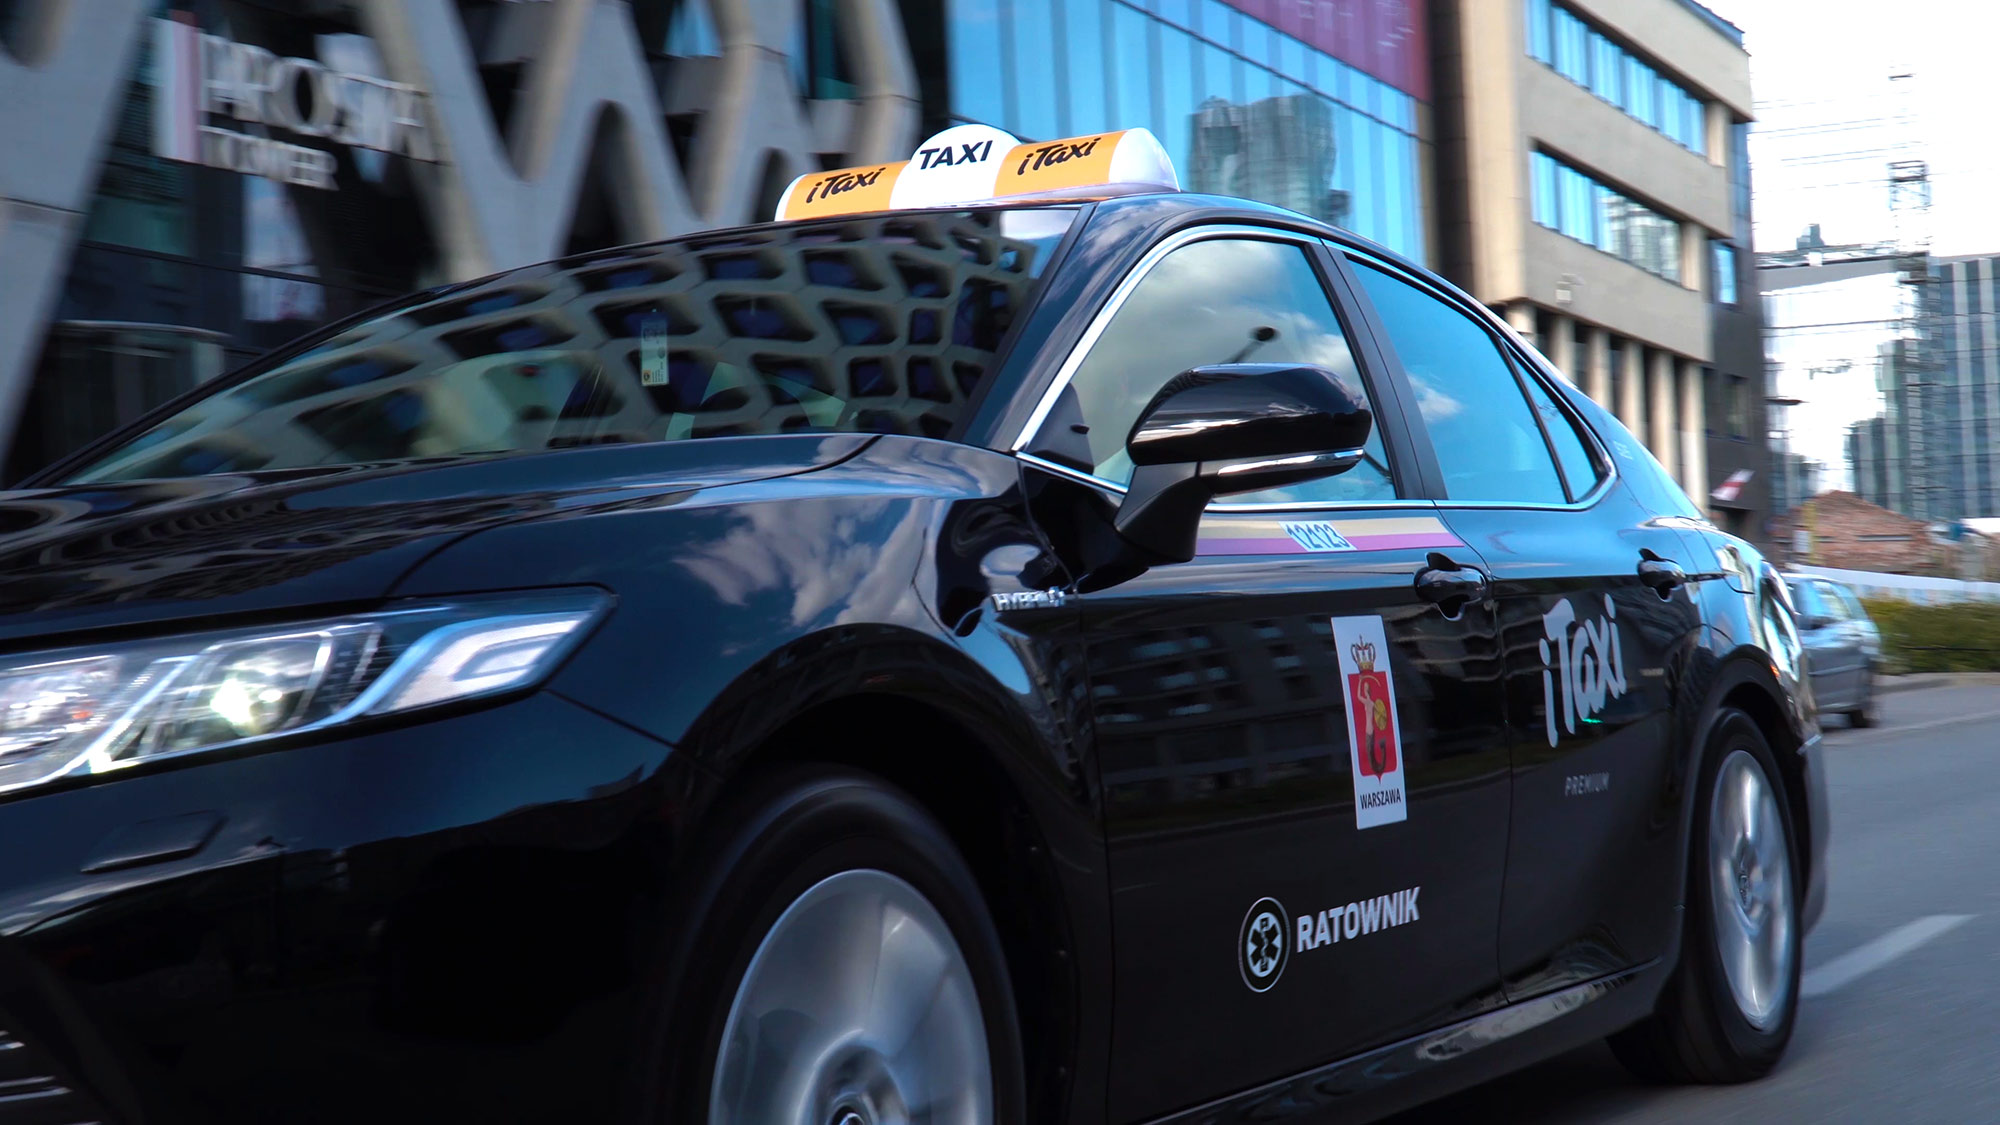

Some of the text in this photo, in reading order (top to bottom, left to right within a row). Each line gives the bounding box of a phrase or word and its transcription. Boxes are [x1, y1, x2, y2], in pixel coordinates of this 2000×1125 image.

[920, 140, 993, 170] TAXI
[1017, 137, 1102, 175] iTaxi
[806, 167, 887, 203] iTaxi
[1286, 524, 1350, 549] 12123
[1539, 593, 1627, 748] iTaxi
[1360, 788, 1402, 810] WARSZAWA
[1565, 772, 1610, 797] PREMIUM
[1297, 886, 1420, 953] RATOWNIK
